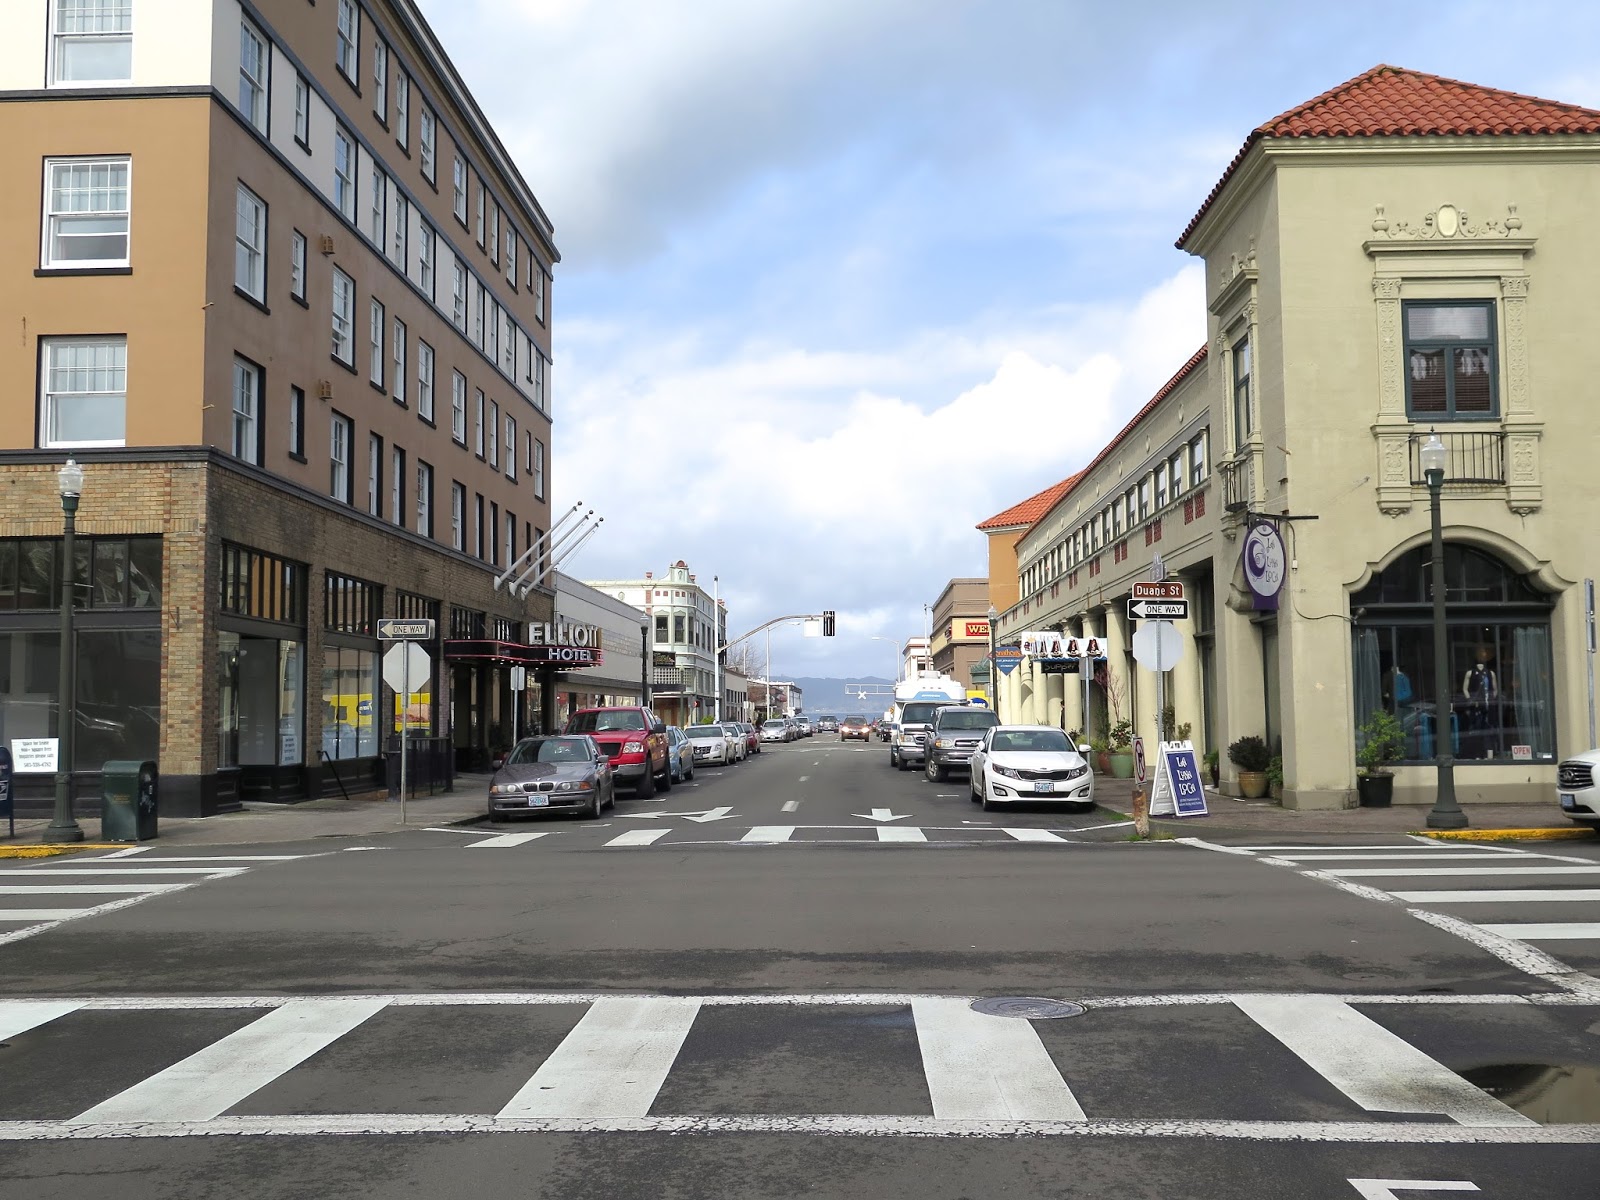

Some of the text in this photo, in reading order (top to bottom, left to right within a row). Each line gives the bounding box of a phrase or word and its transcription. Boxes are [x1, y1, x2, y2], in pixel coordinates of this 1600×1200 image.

[1136, 585, 1180, 597] Duane St
[1146, 605, 1181, 614] ONE WAY
[393, 625, 425, 634] ONE WAY
[548, 647, 593, 661] HOTEL
[1513, 746, 1530, 755] OPEN
